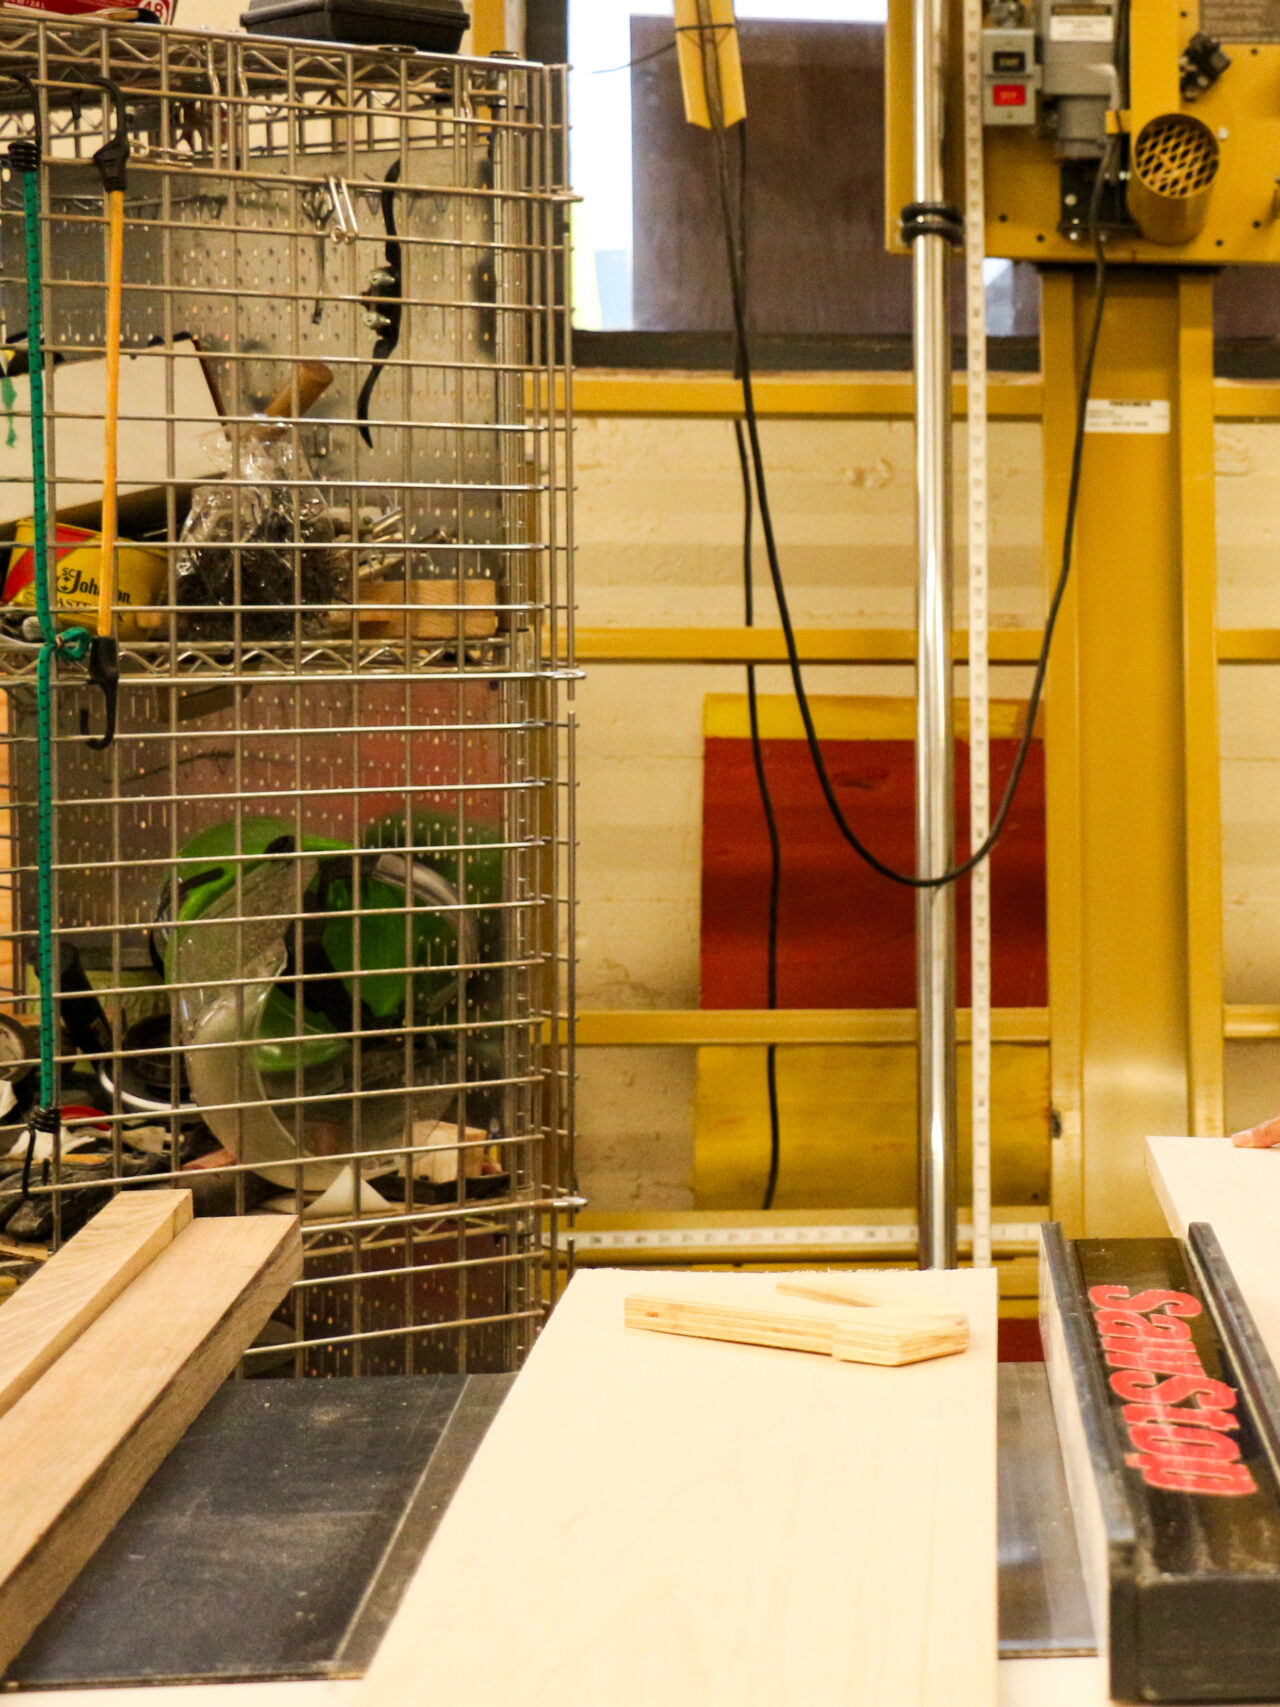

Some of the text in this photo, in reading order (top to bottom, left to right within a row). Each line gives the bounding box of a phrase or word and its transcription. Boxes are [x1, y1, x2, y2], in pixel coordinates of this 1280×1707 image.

[56, 570, 132, 604] John
[62, 567, 75, 578] SC
[1088, 1285, 1258, 1495] SawStop
